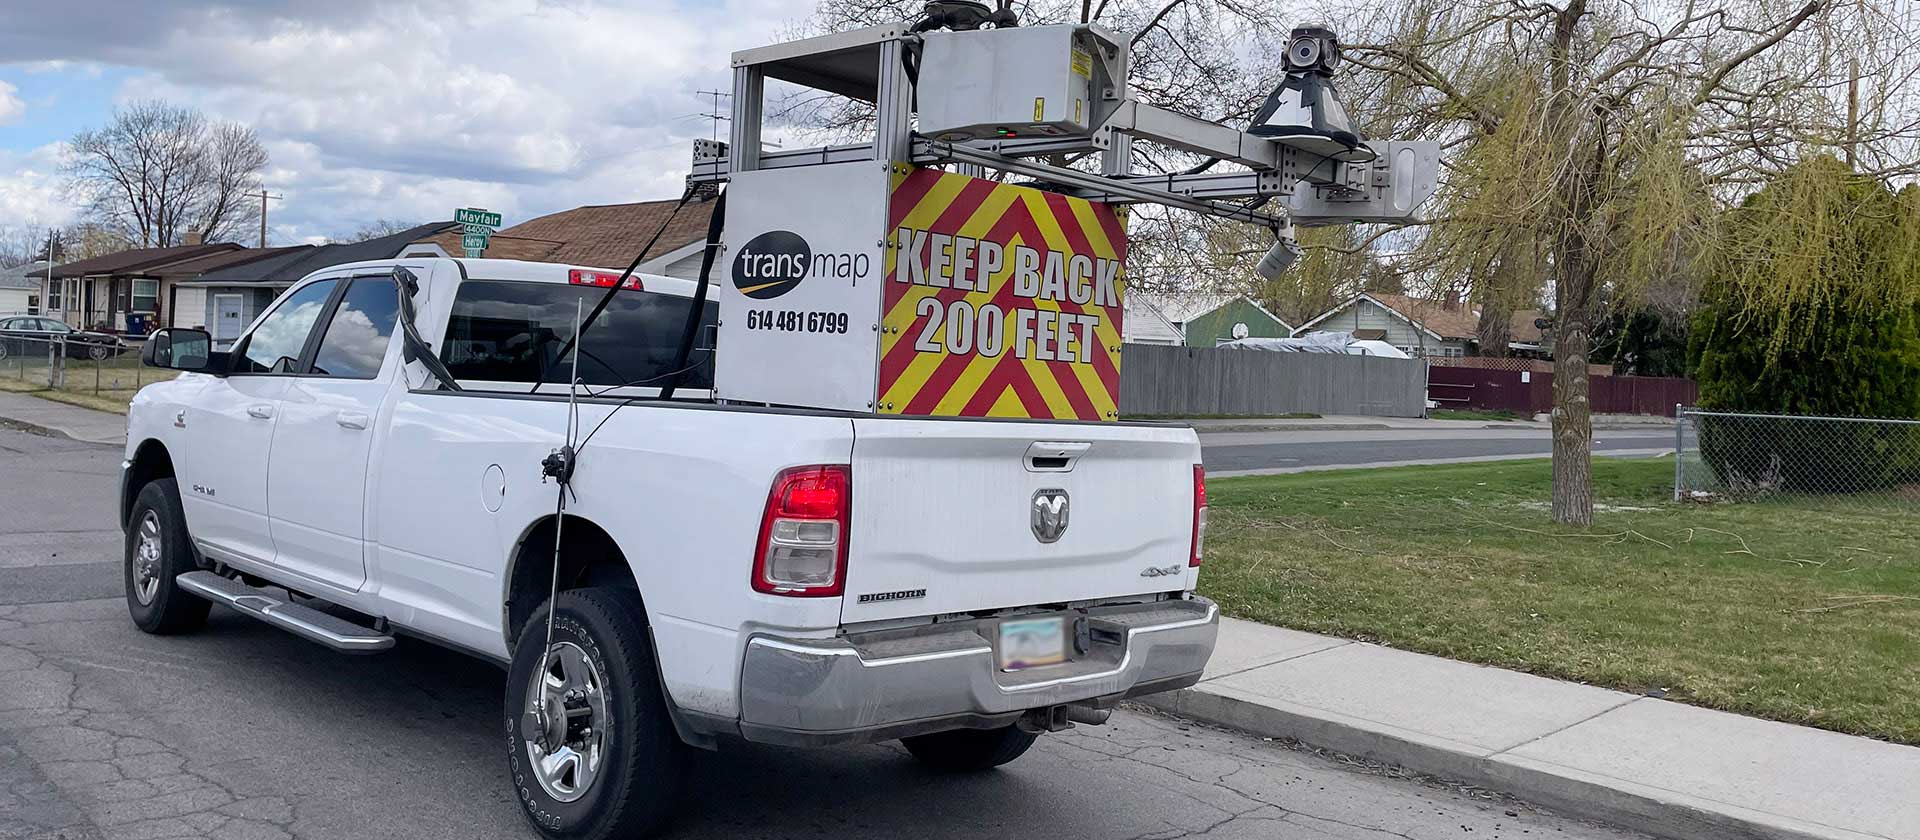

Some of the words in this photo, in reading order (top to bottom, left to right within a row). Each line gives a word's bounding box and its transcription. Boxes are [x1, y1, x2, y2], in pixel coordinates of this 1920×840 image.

[460, 210, 499, 225] Mayfair
[896, 227, 1004, 293] KEEP
[1013, 245, 1120, 308] BACK
[747, 309, 773, 331] 614
[775, 310, 804, 332] 481
[807, 311, 849, 334] 6799
[914, 296, 1005, 358] 200
[1014, 307, 1100, 364] FEET
[858, 588, 927, 604] BIGHORN
